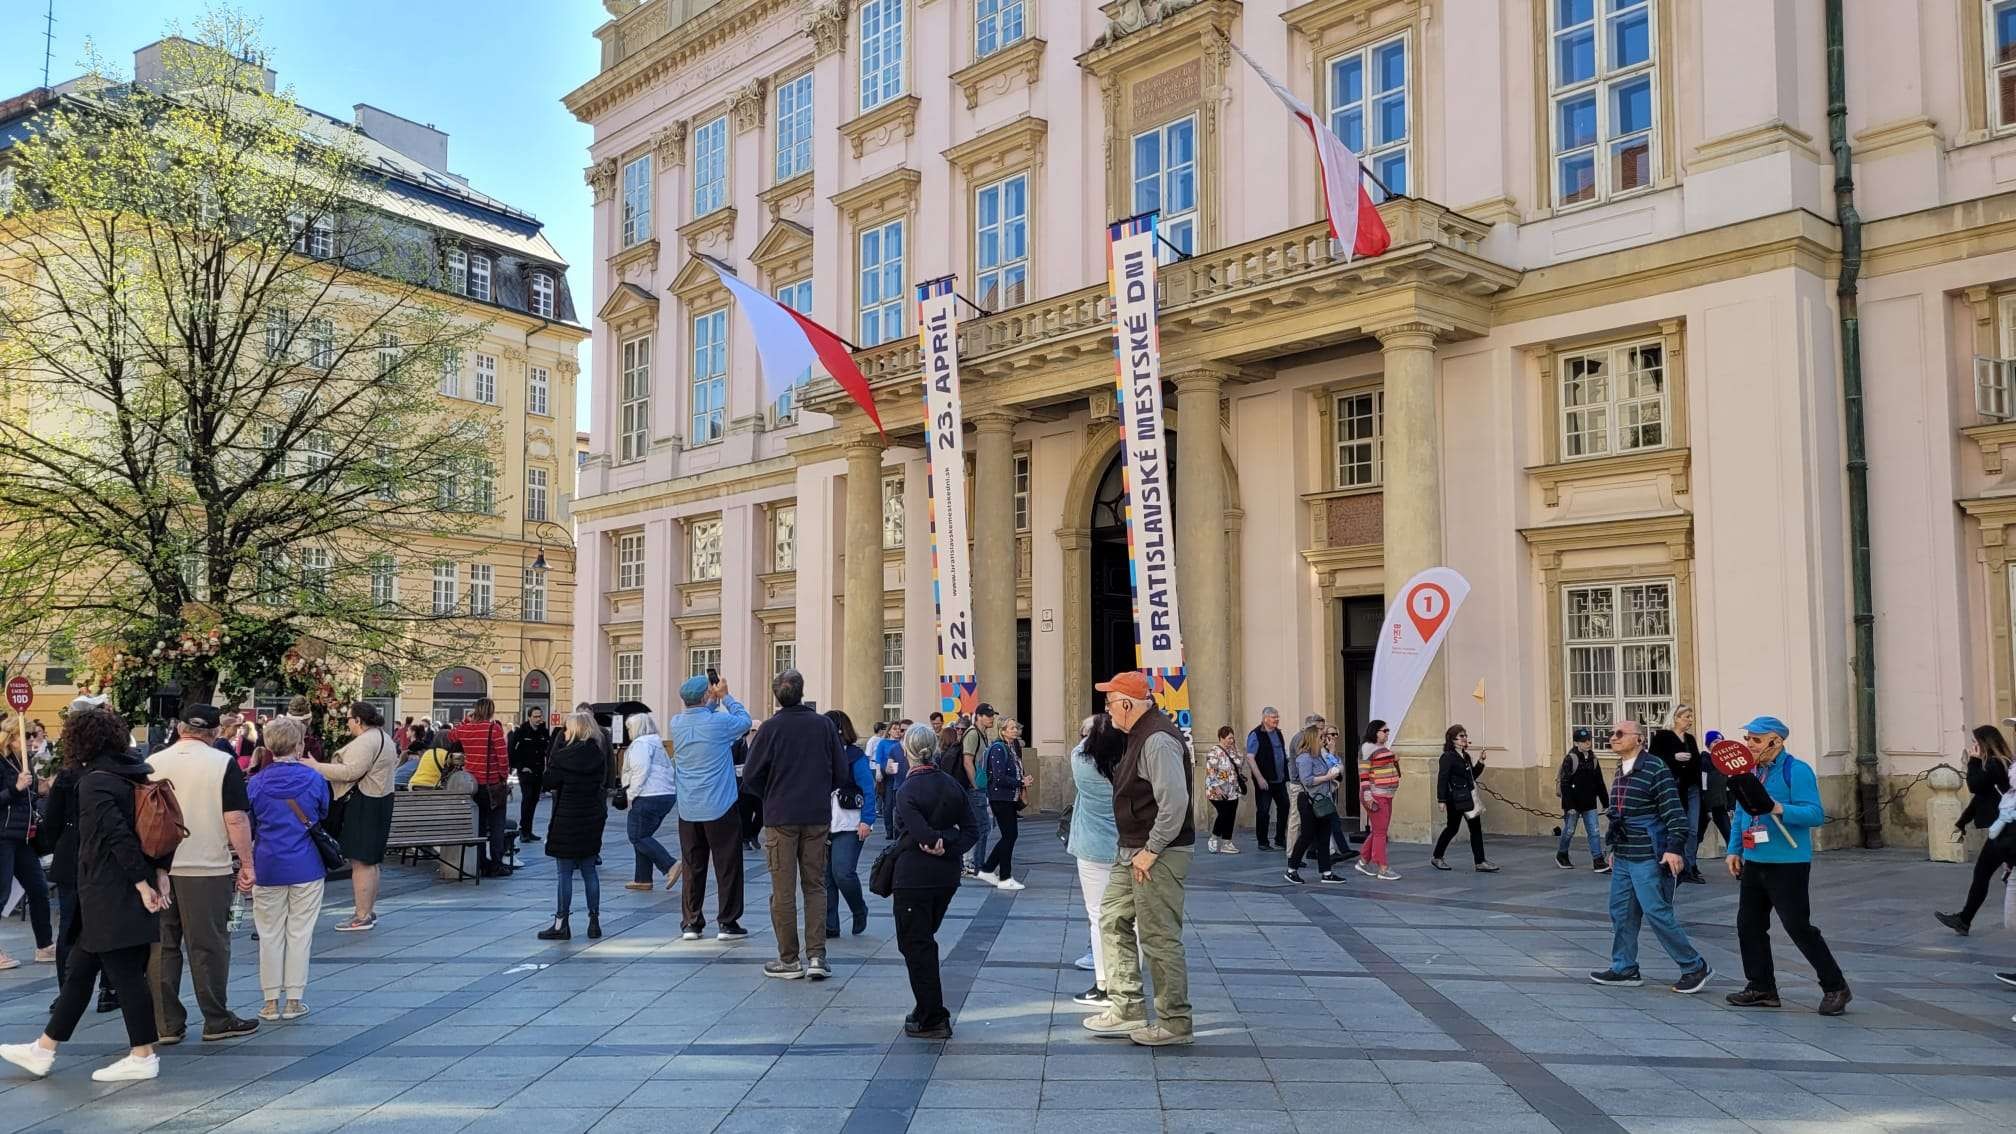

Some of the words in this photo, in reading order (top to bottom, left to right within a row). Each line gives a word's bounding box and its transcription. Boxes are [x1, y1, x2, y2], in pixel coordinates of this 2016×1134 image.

[1124, 250, 1146, 304] DNI
[927, 307, 951, 394] APRÍL
[1124, 312, 1156, 441] MESTSKÉ
[938, 401, 954, 450] 23.
[1133, 448, 1172, 651] BRATISLAVSKÉ
[1424, 596, 1432, 613] 1
[950, 611, 967, 660] 22.
[12, 694, 28, 703] 10D
[1713, 743, 1740, 757] VIKING
[1725, 756, 1748, 770] 10B
